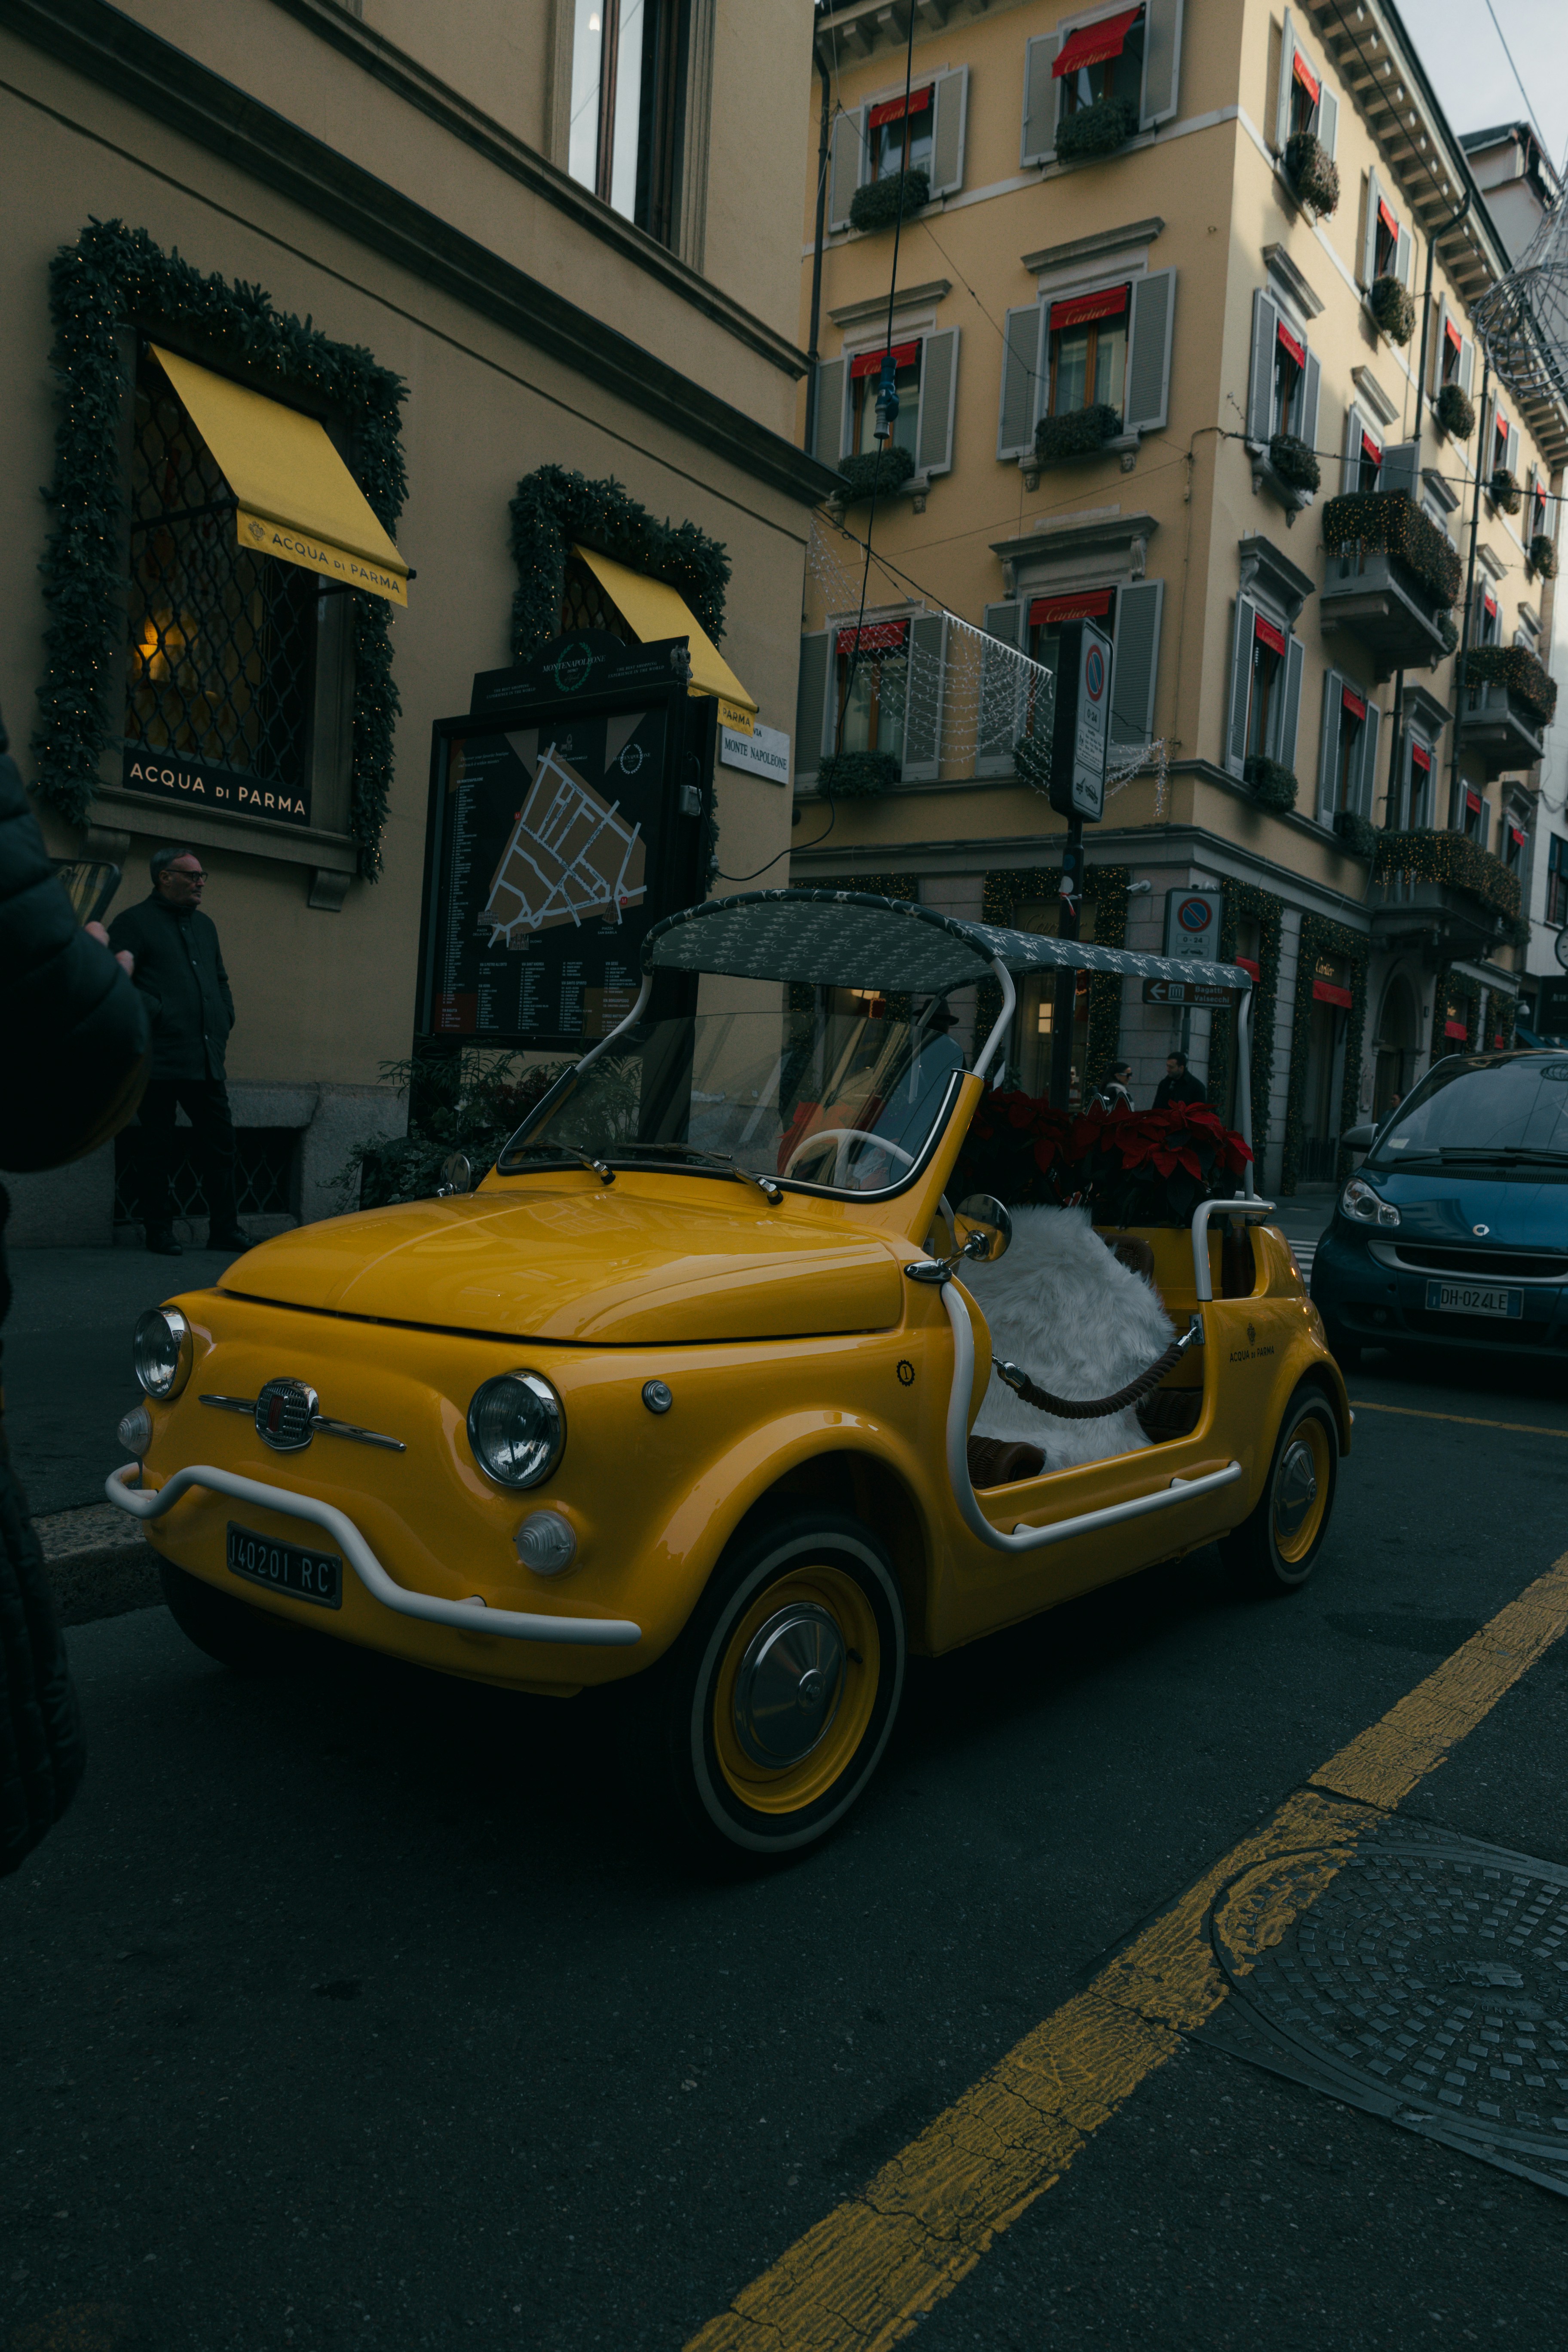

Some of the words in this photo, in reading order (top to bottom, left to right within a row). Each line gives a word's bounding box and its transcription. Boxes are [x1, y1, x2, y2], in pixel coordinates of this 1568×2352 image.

[1064, 48, 1111, 74] Cartier
[1066, 306, 1109, 325] Cartier
[273, 532, 328, 565] ACQUA
[351, 564, 400, 594] PARMA
[1046, 606, 1090, 622] Cartier
[542, 655, 606, 672] MONTENAPOLEONE
[723, 708, 751, 727] PARMA
[753, 728, 762, 737] VIA
[725, 738, 748, 756] MONTE
[750, 747, 787, 770] NAPOLEONE
[129, 762, 205, 793] ACQUA
[238, 787, 306, 815] PARMA
[1194, 995, 1230, 1004] Valsecchi
[1195, 986, 1223, 994] Bagatti
[1230, 1350, 1250, 1363] ACQUA
[1257, 1345, 1274, 1357] PARMA
[232, 1536, 288, 1583] 140201
[302, 1558, 328, 1593] RC
